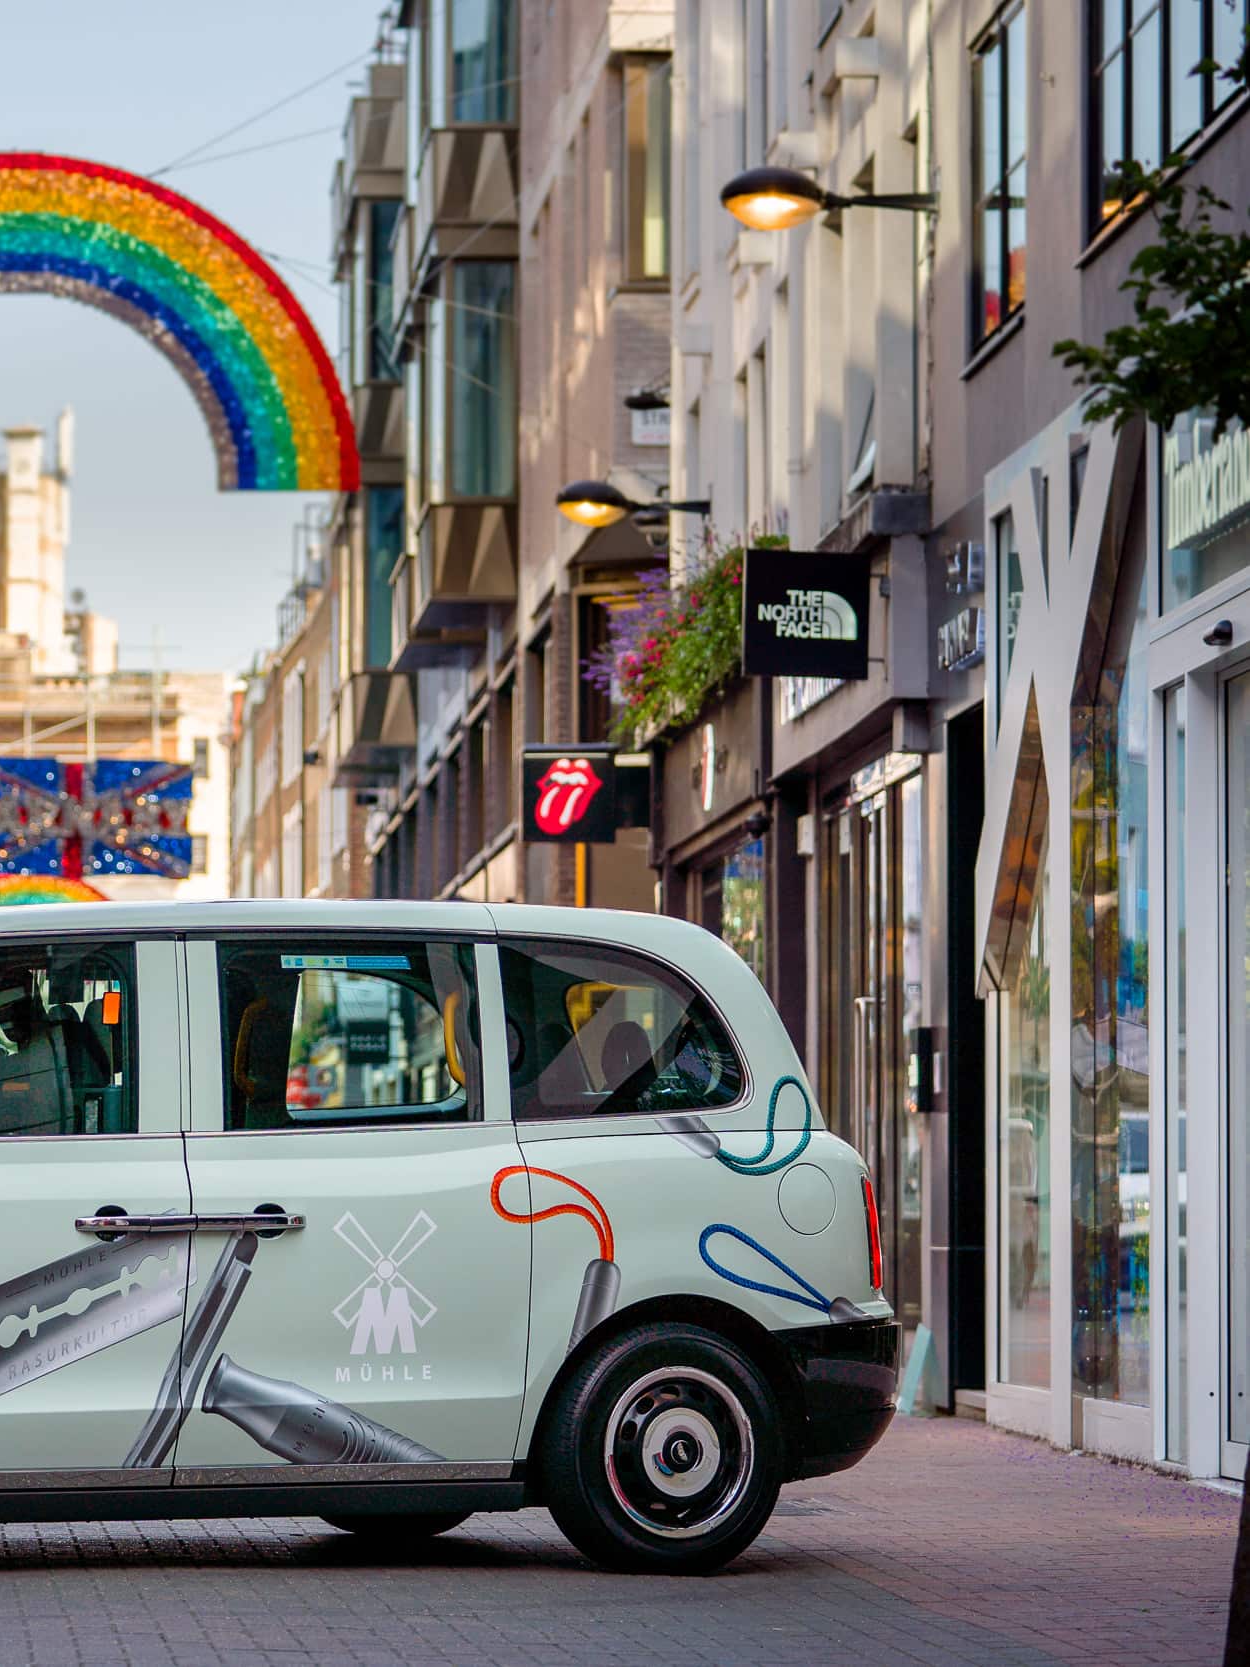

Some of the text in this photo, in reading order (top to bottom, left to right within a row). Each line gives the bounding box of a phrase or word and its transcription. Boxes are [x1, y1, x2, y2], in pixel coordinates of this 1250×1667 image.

[786, 589, 823, 607] THE
[758, 603, 822, 622] NORTH
[775, 621, 823, 638] FACE
[335, 1362, 432, 1383] MÜHLE
